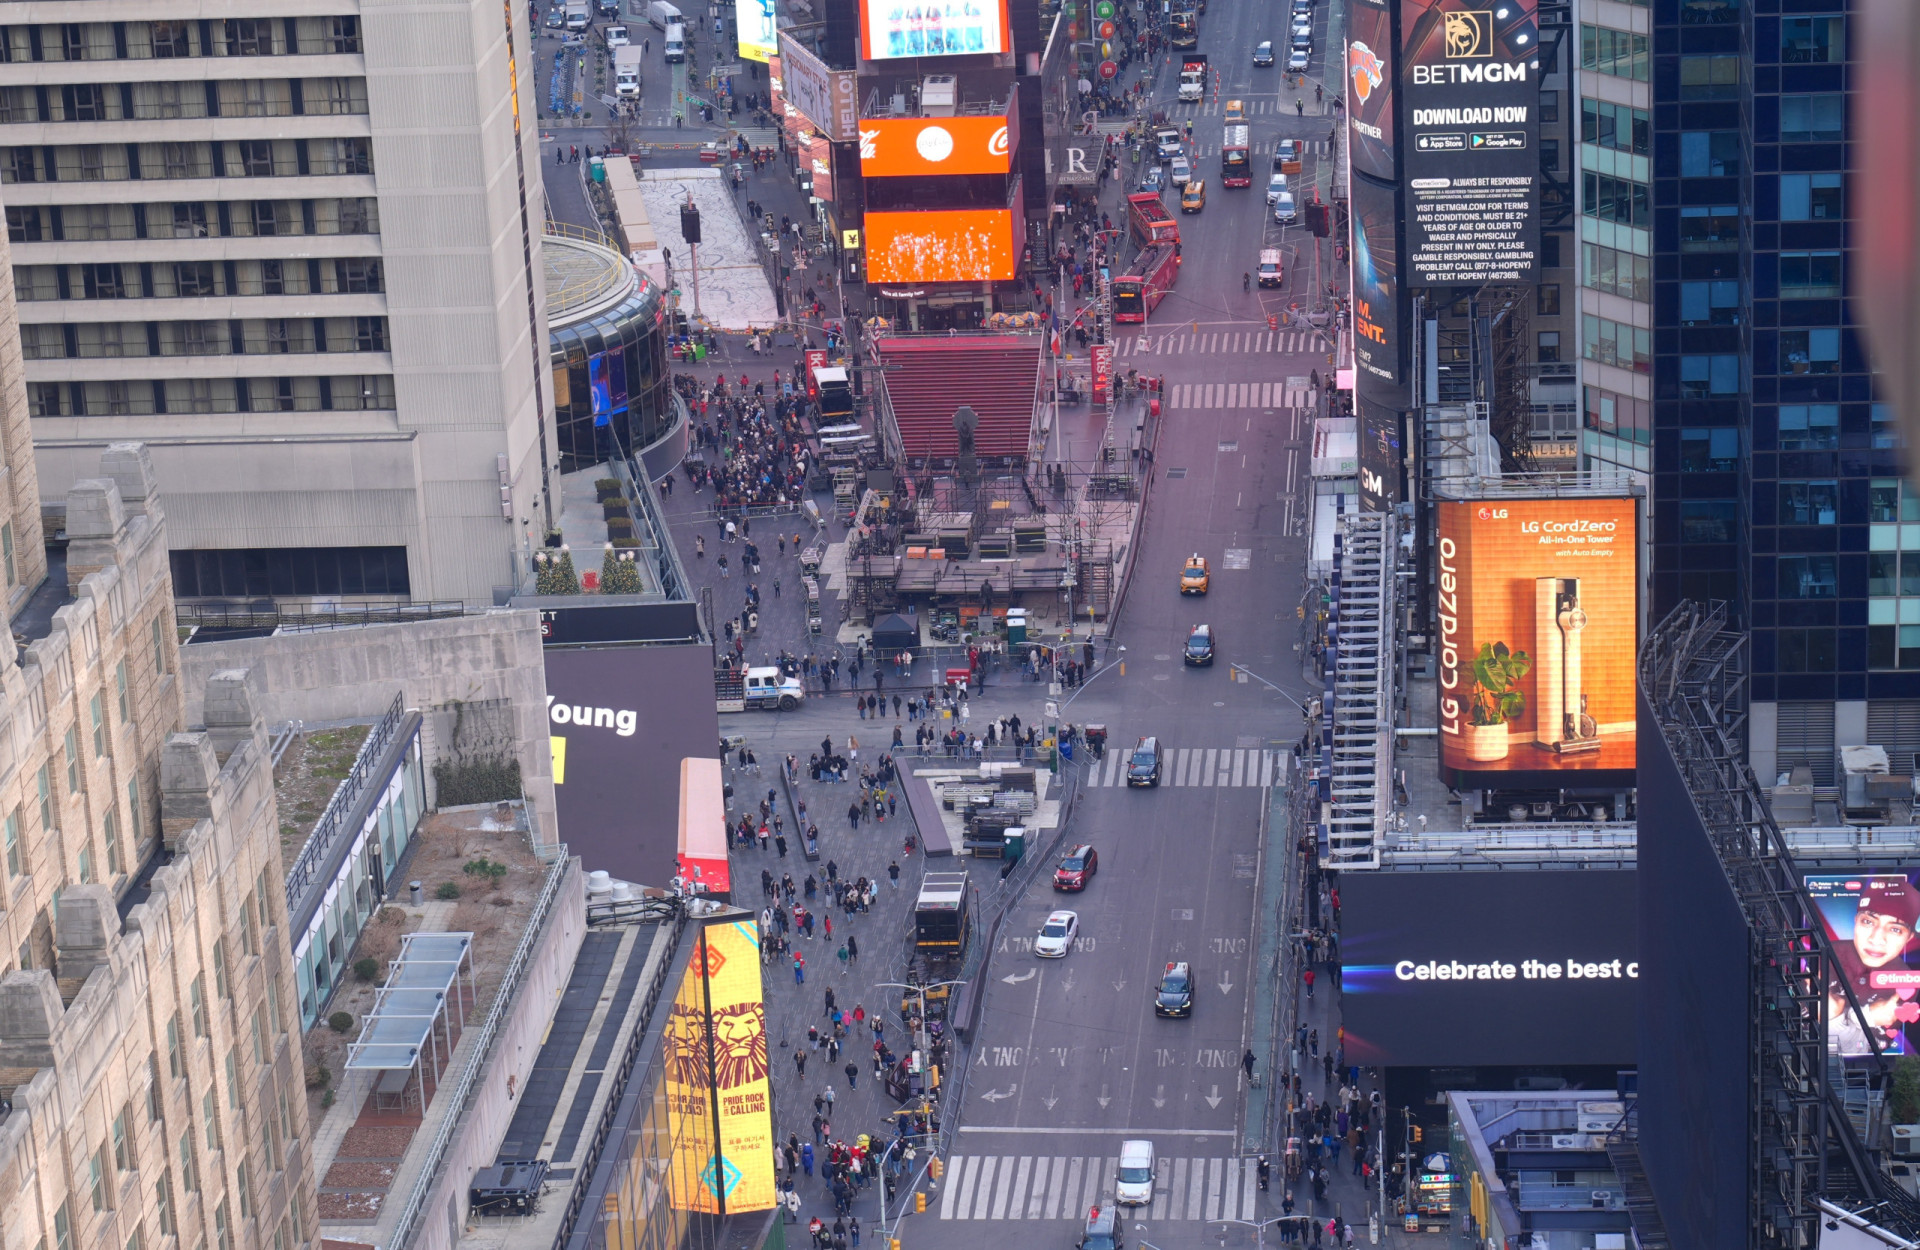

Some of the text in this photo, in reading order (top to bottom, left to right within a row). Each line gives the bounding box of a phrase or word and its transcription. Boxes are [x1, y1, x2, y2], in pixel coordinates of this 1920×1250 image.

[1414, 62, 1526, 84] BETMGM
[839, 74, 856, 137] HELLO!
[1414, 106, 1527, 125] DOWNLOAD NOW
[1355, 119, 1382, 139] PARTNER
[1066, 148, 1094, 174] R
[1453, 177, 1532, 186] ALWAYS BET RESPONSIBLY
[1436, 203, 1486, 211] BETMGM.COM
[1434, 213, 1481, 221] CONDITIONS.
[1416, 263, 1453, 271] PROBLEM?
[1475, 261, 1531, 270] (877-8-HOPENY)
[1492, 508, 1508, 519] LG
[1521, 521, 1538, 534] LG
[1538, 535, 1614, 544] All-In-One Tower
[1555, 549, 1613, 558] with Auto Empty
[1441, 698, 1459, 736] LG
[1395, 960, 1516, 980] Celebrate
[1522, 958, 1561, 979] the
[1567, 958, 1622, 978] best
[723, 1093, 764, 1106] PRIDE ROCK
[730, 1102, 765, 1116] CALLING
